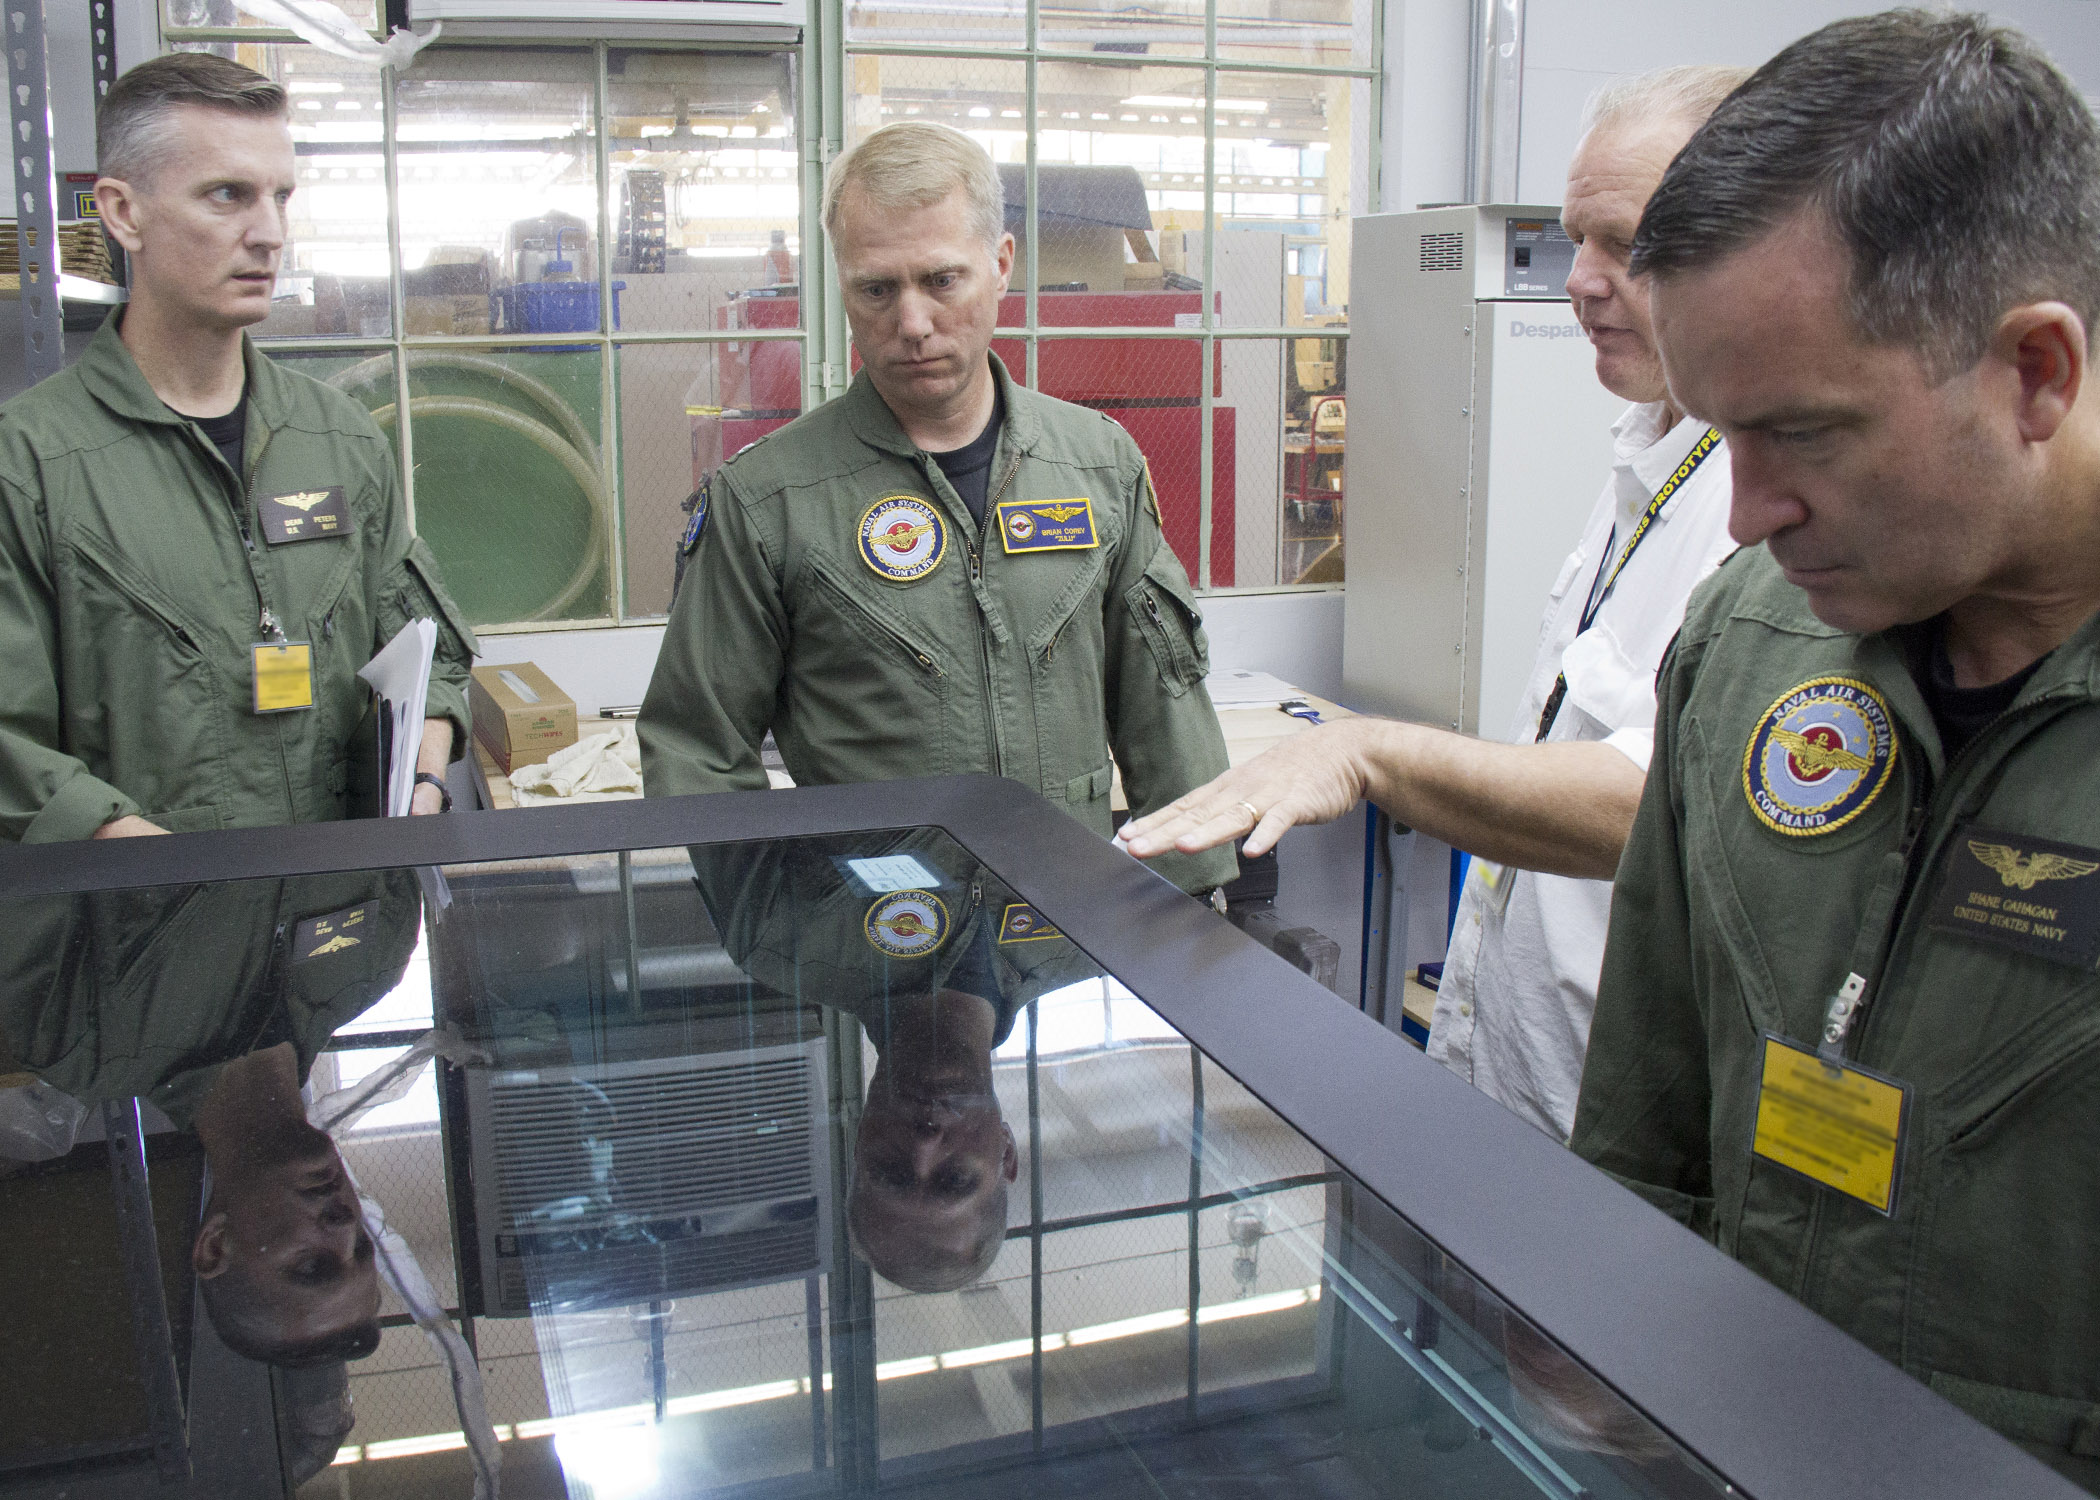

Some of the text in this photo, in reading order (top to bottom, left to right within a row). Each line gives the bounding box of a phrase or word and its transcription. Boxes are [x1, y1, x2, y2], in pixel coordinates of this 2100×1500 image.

[1510, 320, 1588, 339] Despat
[862, 500, 935, 537] NAVAL AIR SYSTEMS
[888, 558, 934, 577] COMMAND
[1772, 684, 1891, 757] NAVAL AIR SYSTEMS
[1755, 790, 1827, 827] COMMAND
[1953, 905, 2067, 942] UNITED STATES NAVY
